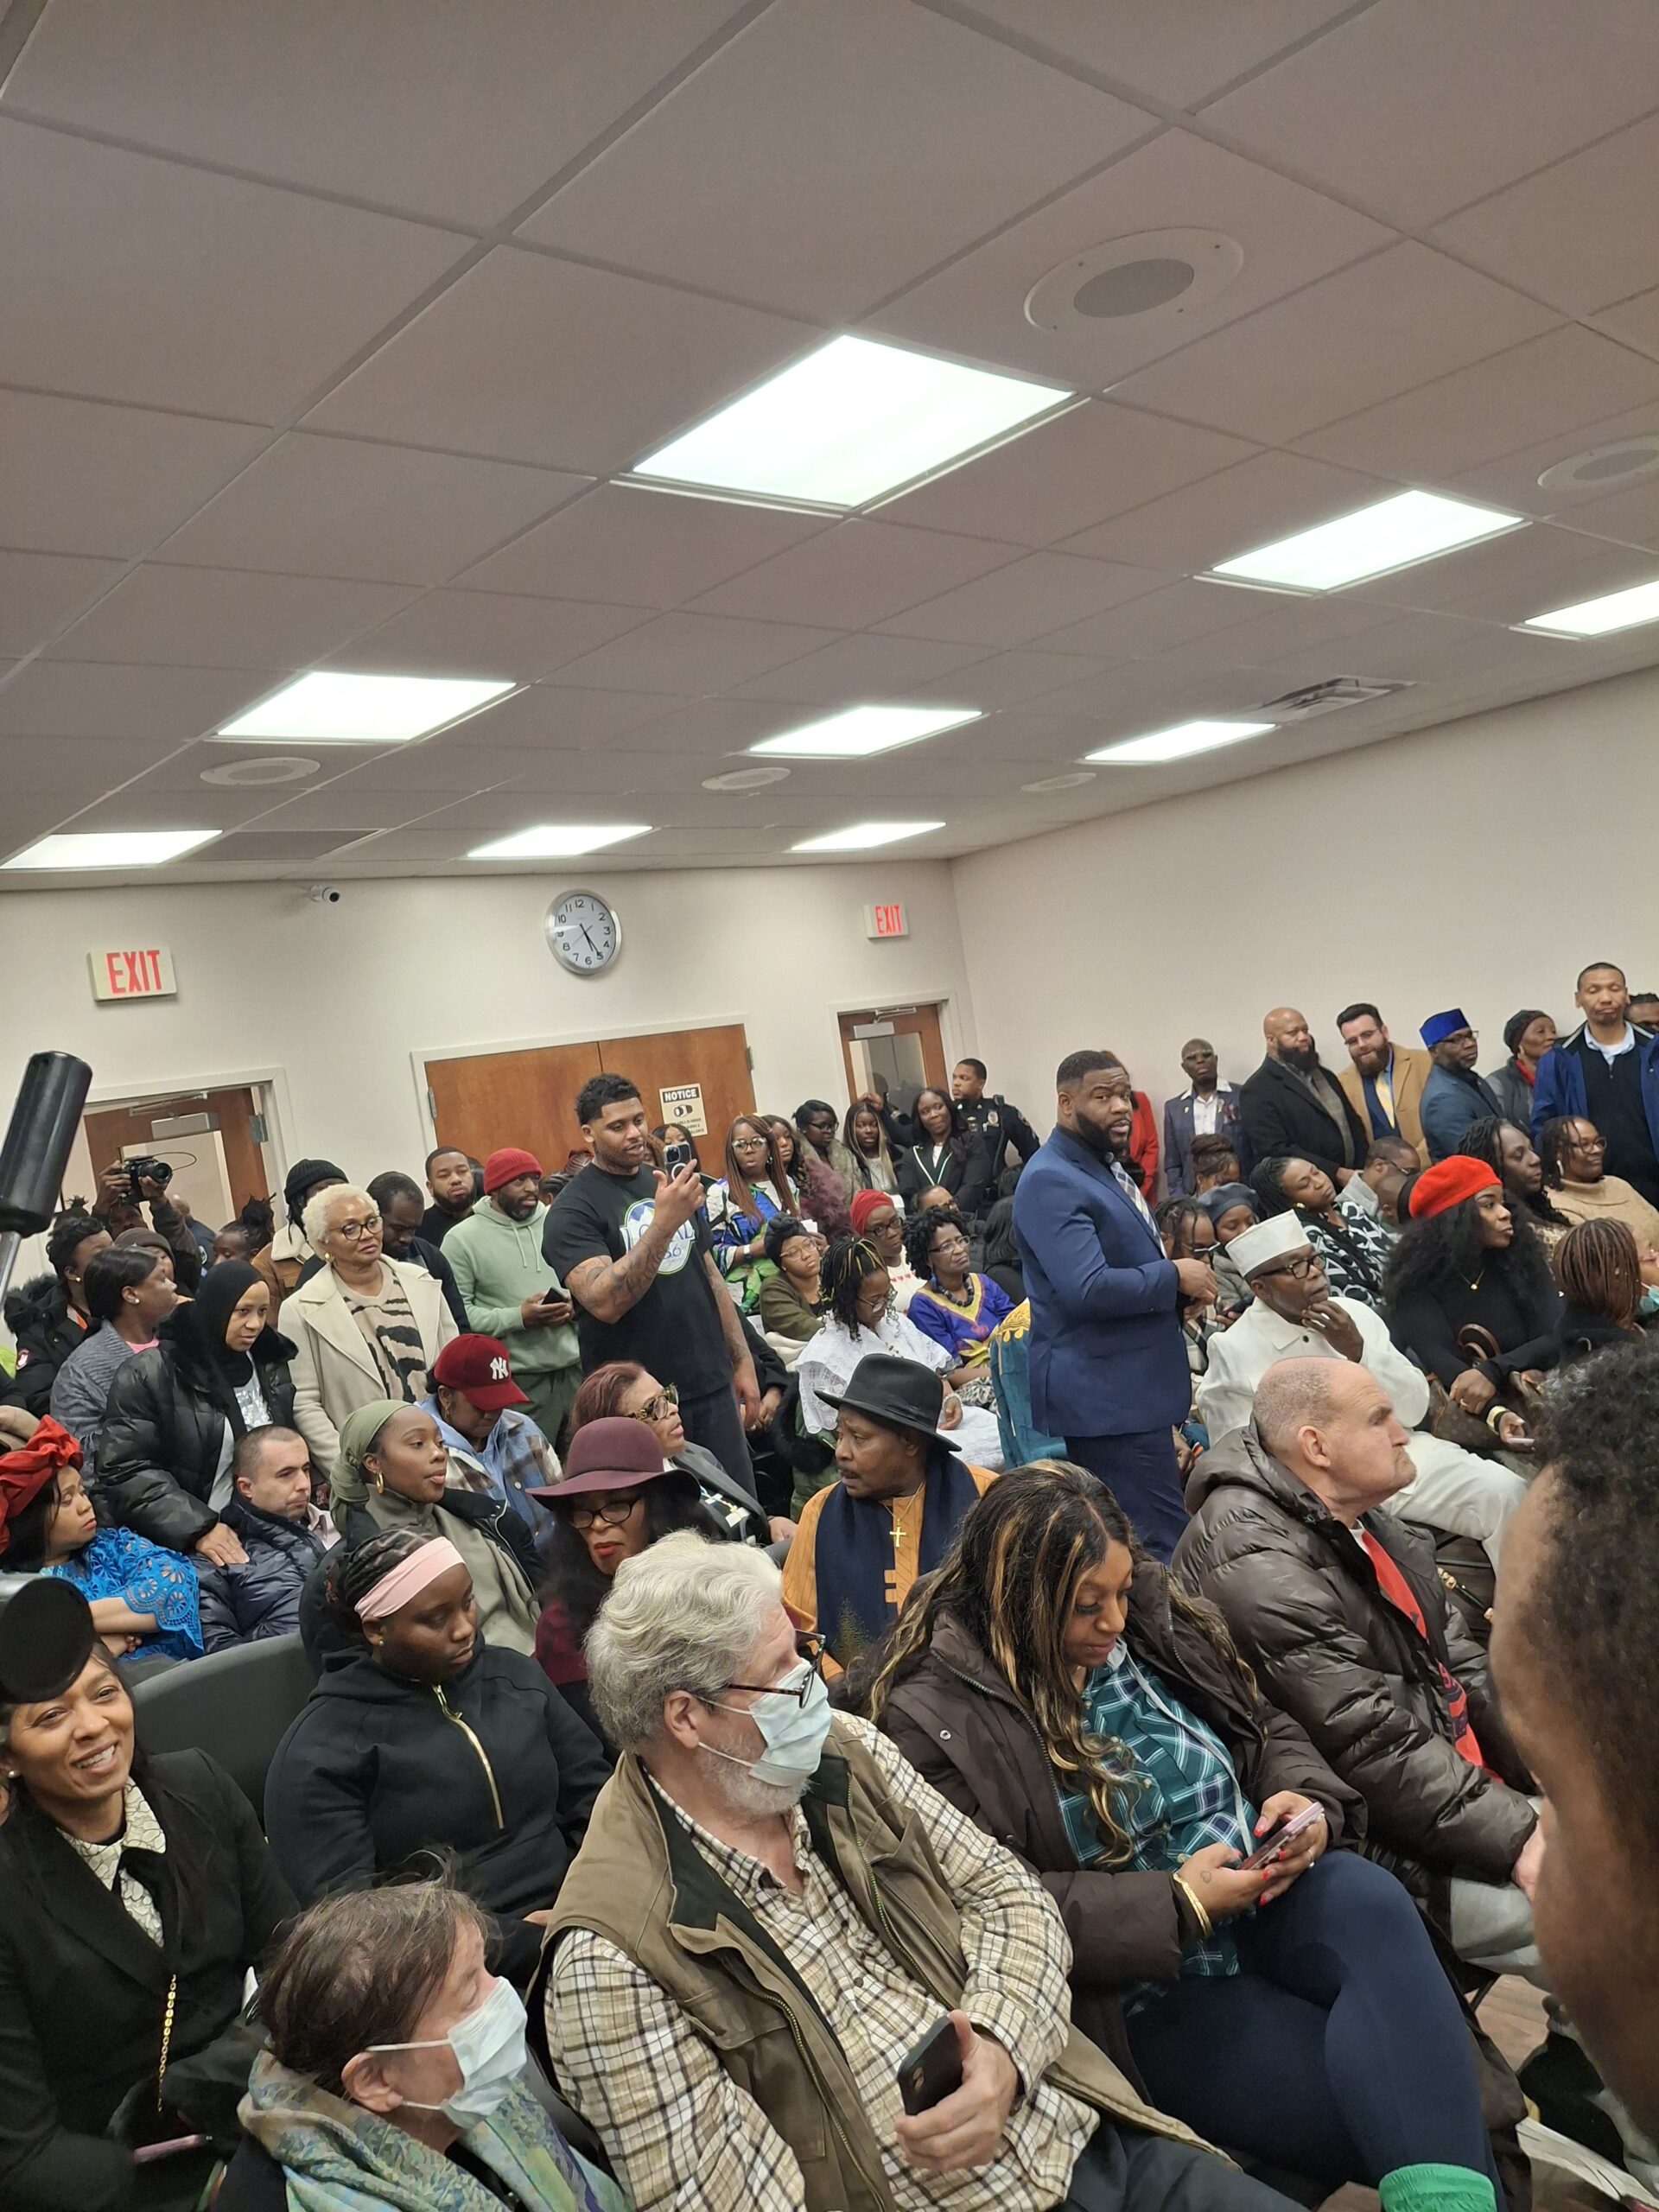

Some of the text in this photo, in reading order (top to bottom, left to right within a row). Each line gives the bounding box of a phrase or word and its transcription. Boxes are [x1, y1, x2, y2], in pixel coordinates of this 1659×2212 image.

[565, 903, 572, 912] 11
[575, 899, 585, 908] 12
[557, 914, 567, 924] 10
[598, 912, 606, 921] 2
[875, 905, 902, 933] EXIT
[603, 926, 611, 936] 3
[563, 943, 570, 951] 8
[573, 953, 580, 962] 7
[584, 957, 592, 965] 6
[106, 950, 162, 994] EXIT
[664, 1088, 697, 1102] NOTICE
[489, 1357, 509, 1381] NY
